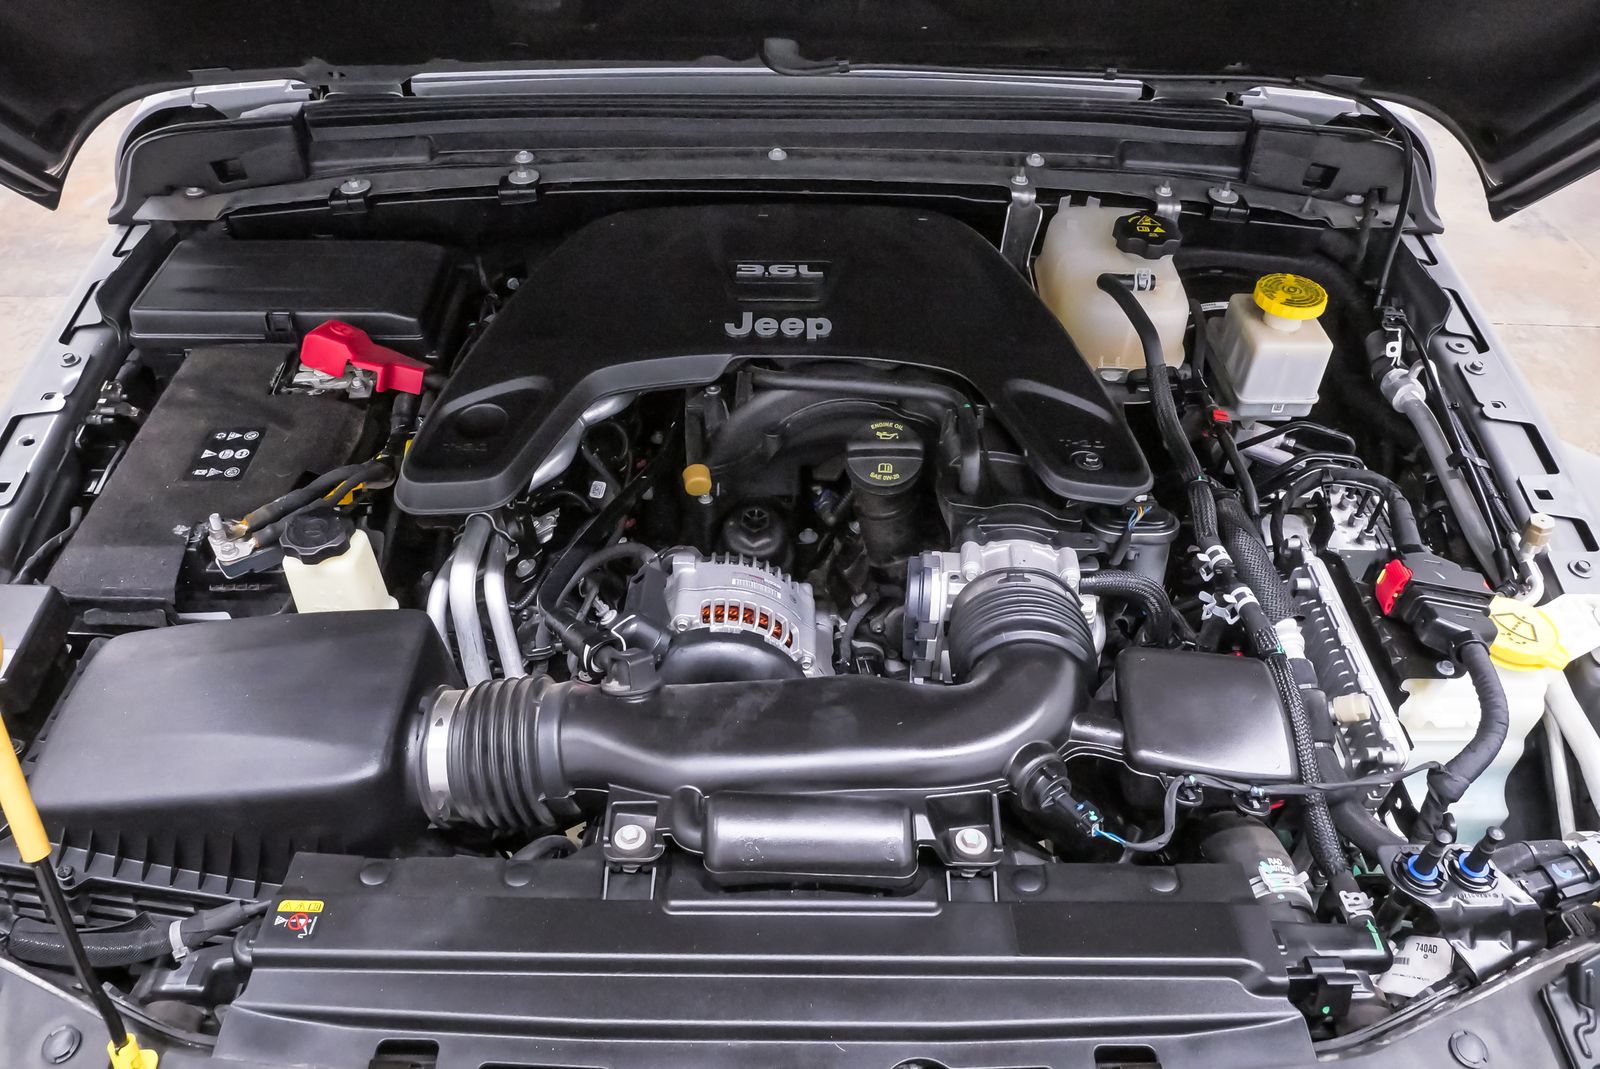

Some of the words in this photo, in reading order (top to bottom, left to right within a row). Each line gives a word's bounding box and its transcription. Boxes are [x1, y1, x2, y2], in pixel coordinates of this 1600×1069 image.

[736, 264, 824, 278] 3.6L
[724, 311, 833, 340] Jeep
[870, 422, 893, 430] ENGINE
[894, 423, 904, 431] OIL
[869, 472, 882, 480] SAE
[1415, 942, 1438, 954] 740AD
